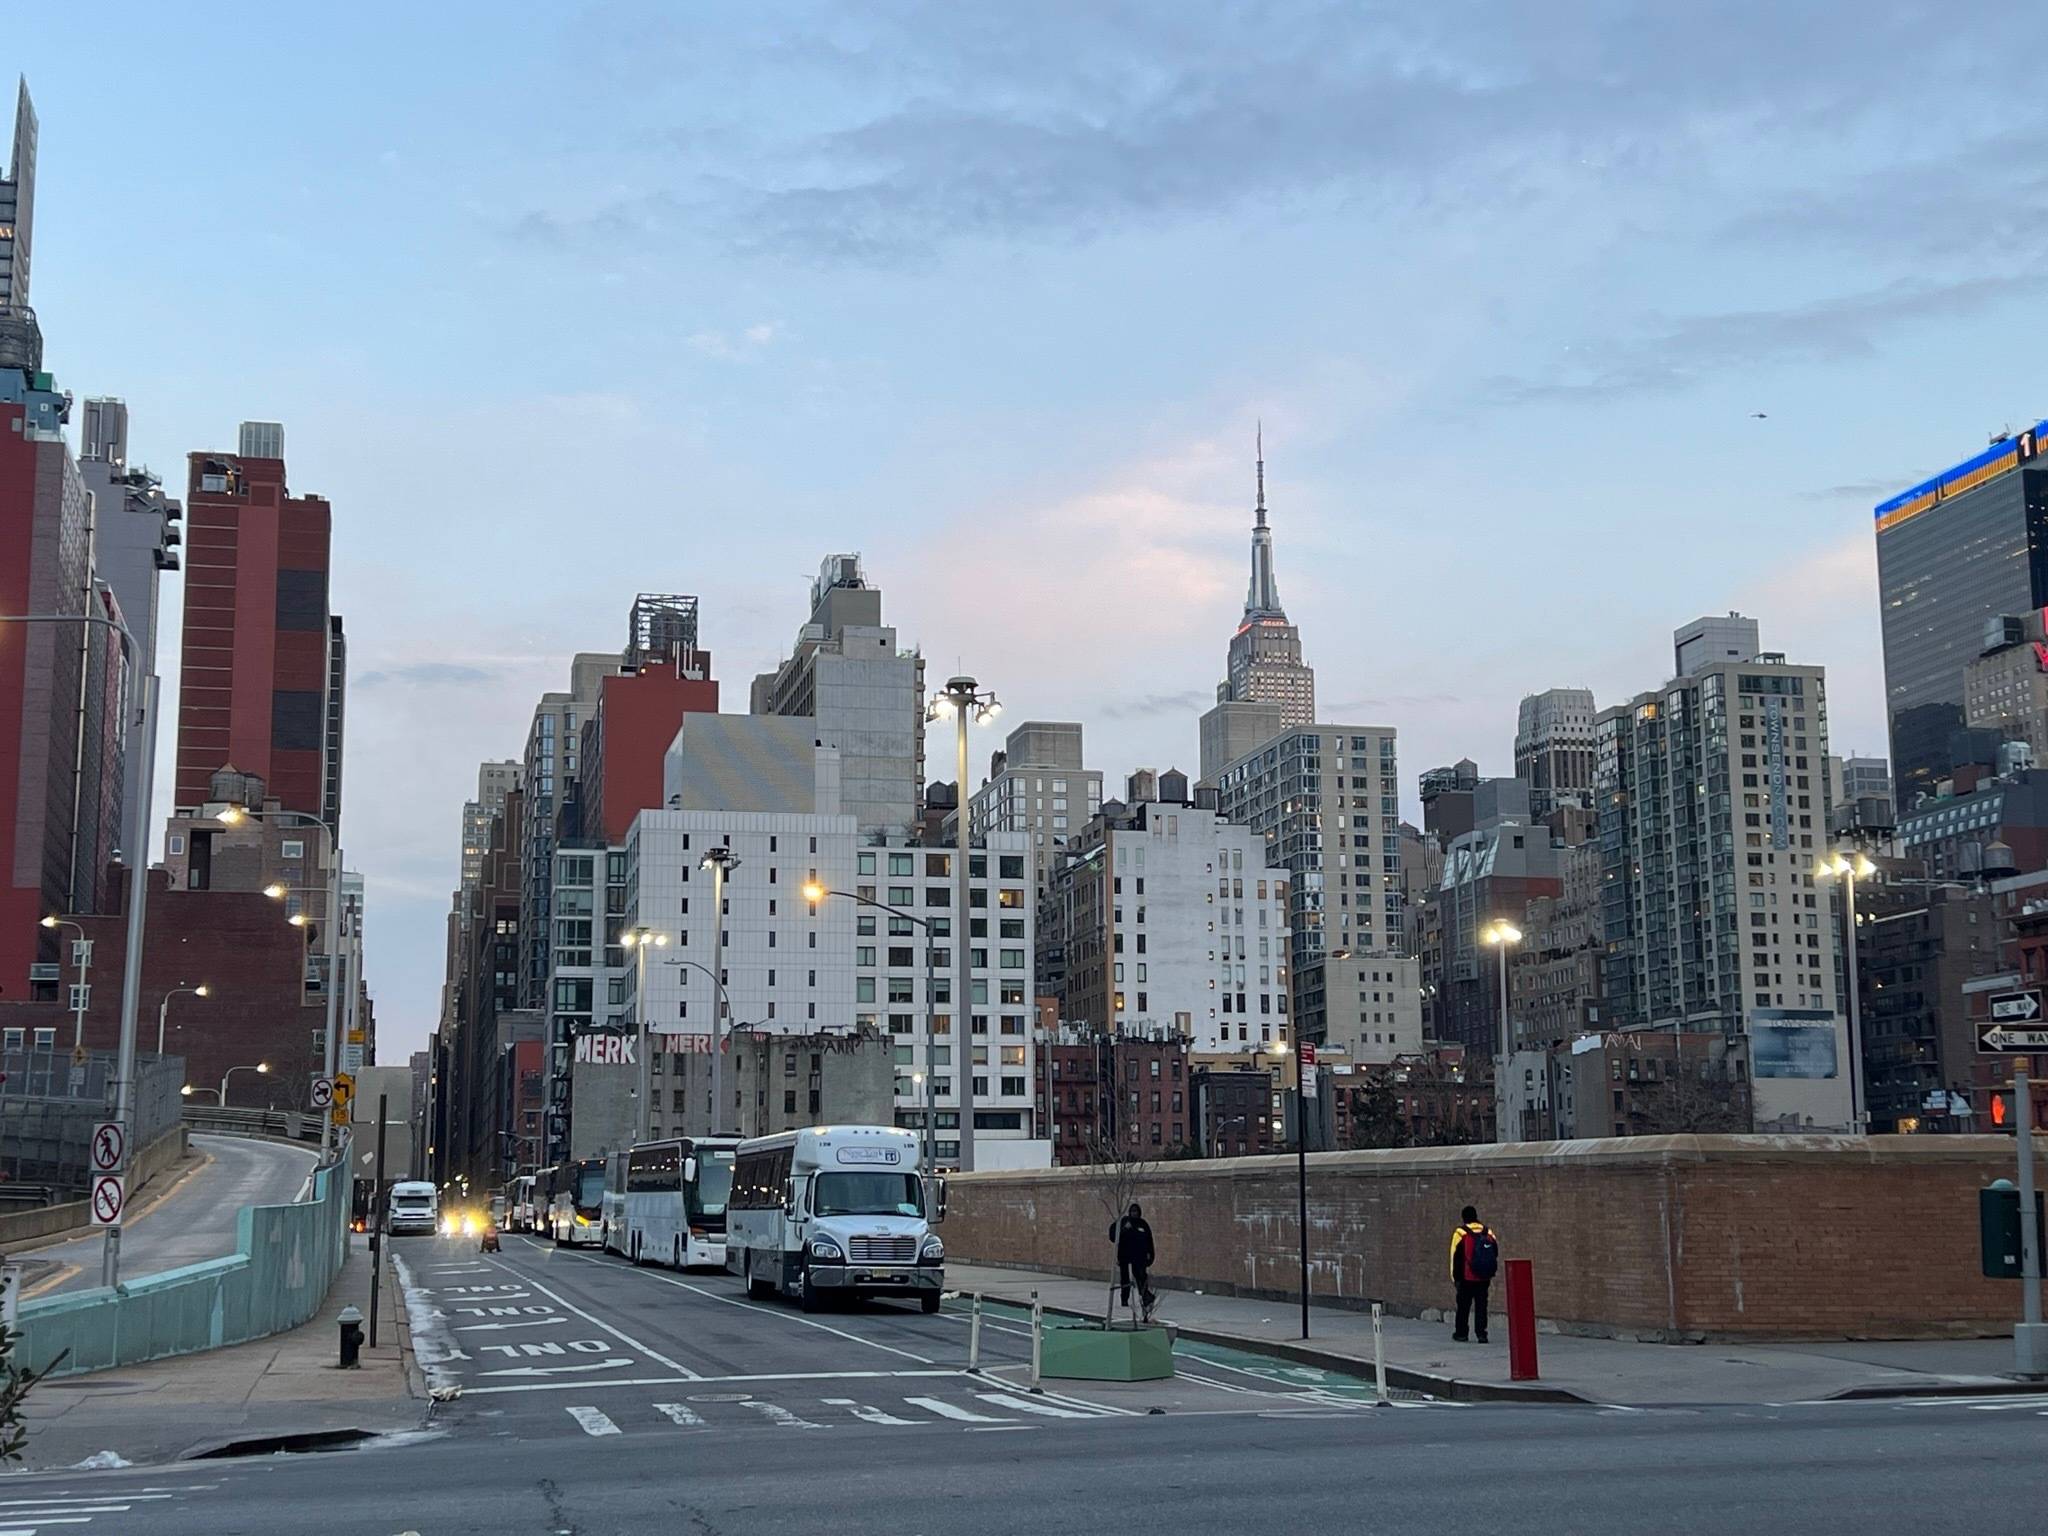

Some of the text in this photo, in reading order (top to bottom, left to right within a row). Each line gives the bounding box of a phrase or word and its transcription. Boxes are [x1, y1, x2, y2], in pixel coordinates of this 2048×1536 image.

[1768, 703, 1786, 849] TOWNSENDNYCCOM
[1996, 1001, 2033, 1015] ONE WAY
[1991, 1032, 2016, 1044] ONE
[575, 1033, 637, 1064] MERK
[431, 1306, 555, 1318] ONLY
[442, 1340, 611, 1361] ONLY
